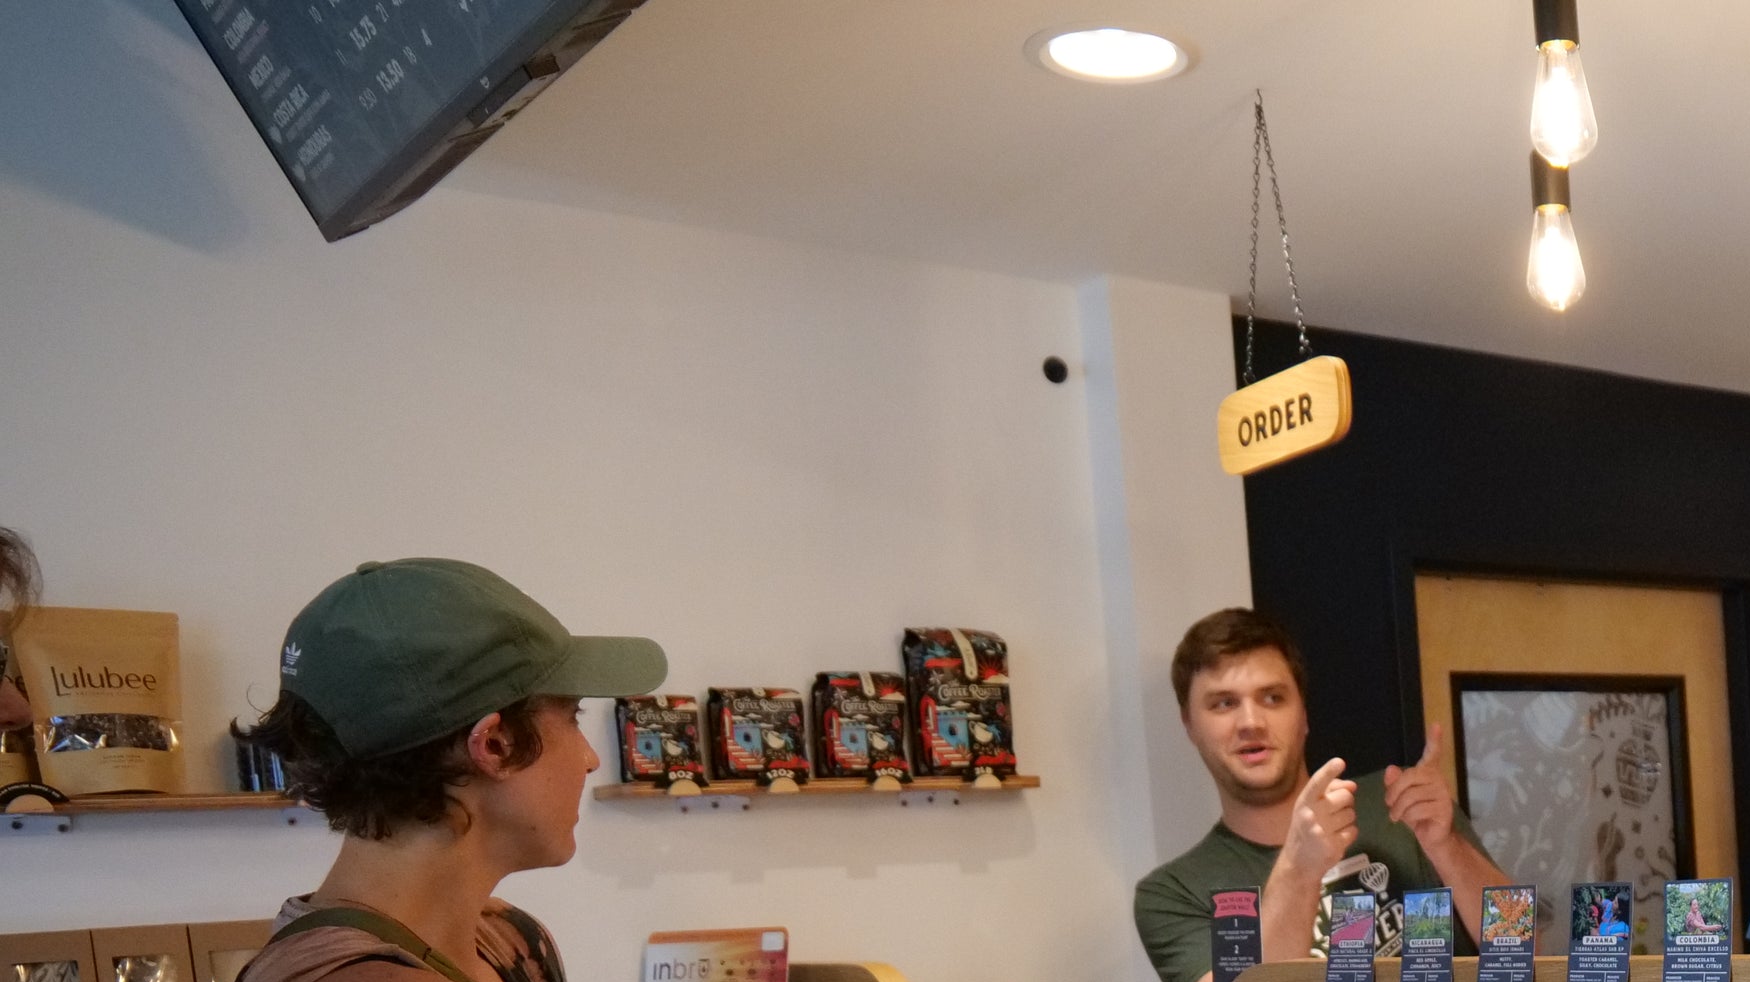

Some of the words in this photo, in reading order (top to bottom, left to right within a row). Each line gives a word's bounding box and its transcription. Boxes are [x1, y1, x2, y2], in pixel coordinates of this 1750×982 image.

[350, 15, 377, 50] 15.75
[248, 54, 274, 90] MEXICO
[376, 59, 405, 93] 13.50
[298, 124, 332, 166] HONDURAS
[1238, 392, 1314, 447] ORDER
[51, 666, 156, 696] Lulubee
[766, 769, 795, 778] 12OZ
[1235, 945, 1239, 954] 2
